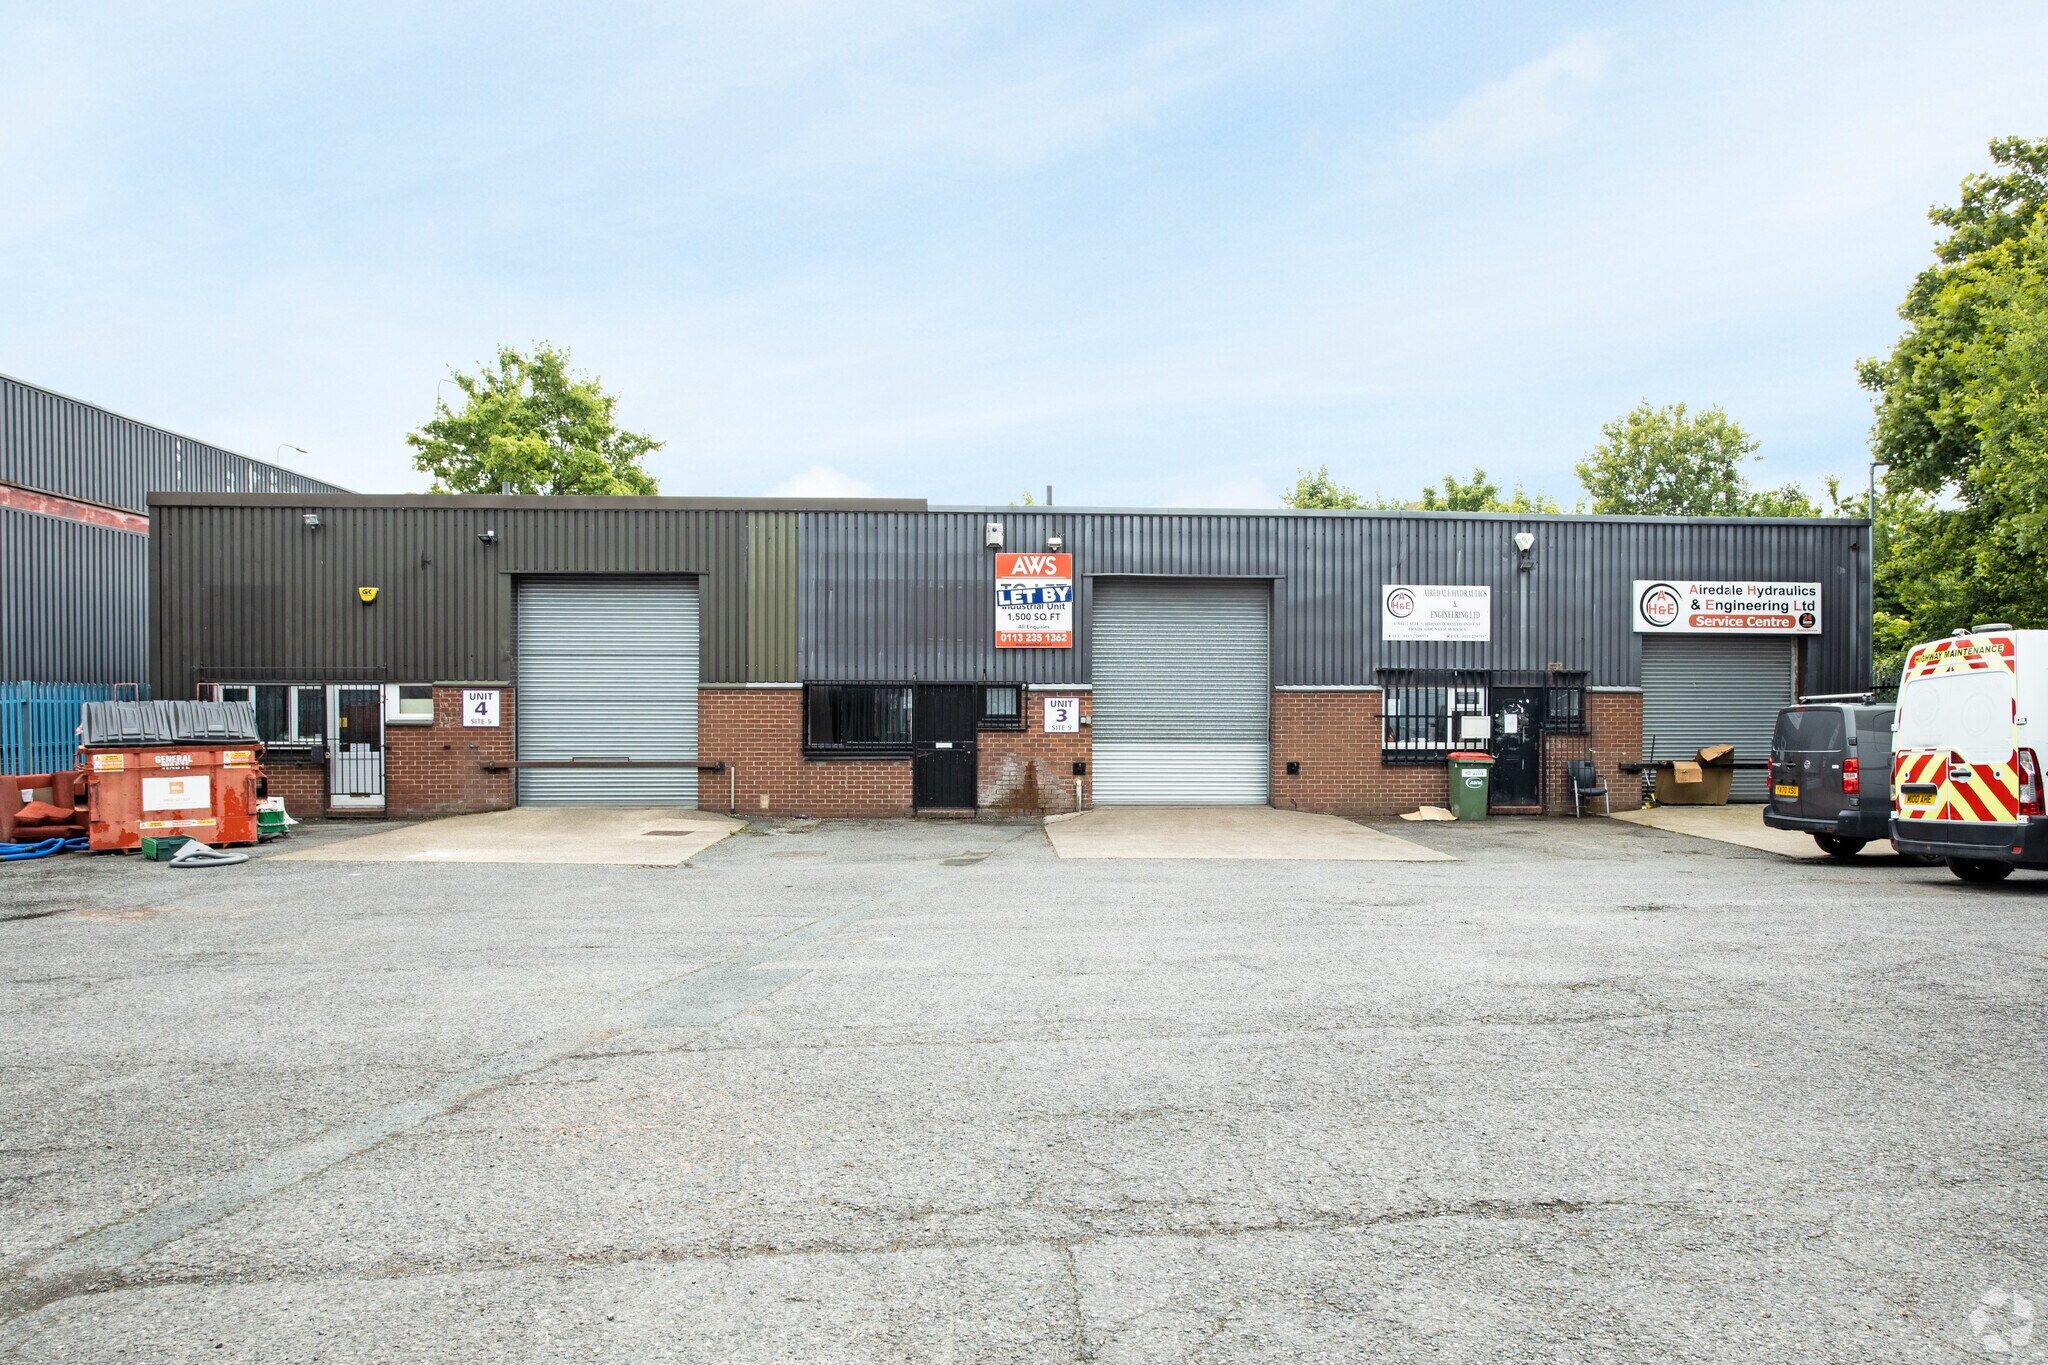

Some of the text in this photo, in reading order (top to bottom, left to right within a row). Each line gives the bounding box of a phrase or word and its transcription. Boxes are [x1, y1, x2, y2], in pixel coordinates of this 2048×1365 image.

[1011, 556, 1057, 575] AWS
[998, 588, 1036, 606] LET
[1042, 586, 1069, 602] BY
[1452, 590, 1487, 598] HYDRAULICS
[1657, 590, 1666, 601] A
[1689, 584, 1816, 598] Airedale Hydraulics
[1392, 601, 1410, 610] H&E
[1648, 603, 1674, 615] H&E
[1691, 599, 1816, 614] & Engineering Ltd
[1007, 613, 1031, 621] 1,500
[1470, 611, 1480, 619] LTD
[1696, 616, 1790, 627] Service Centre
[1000, 633, 1067, 642] 0113 235 1362
[1916, 644, 2003, 663] HIGHWAY MAINTENANCE
[475, 702, 488, 715] 4
[1056, 709, 1067, 722] 3
[155, 755, 193, 763] GENERAL
